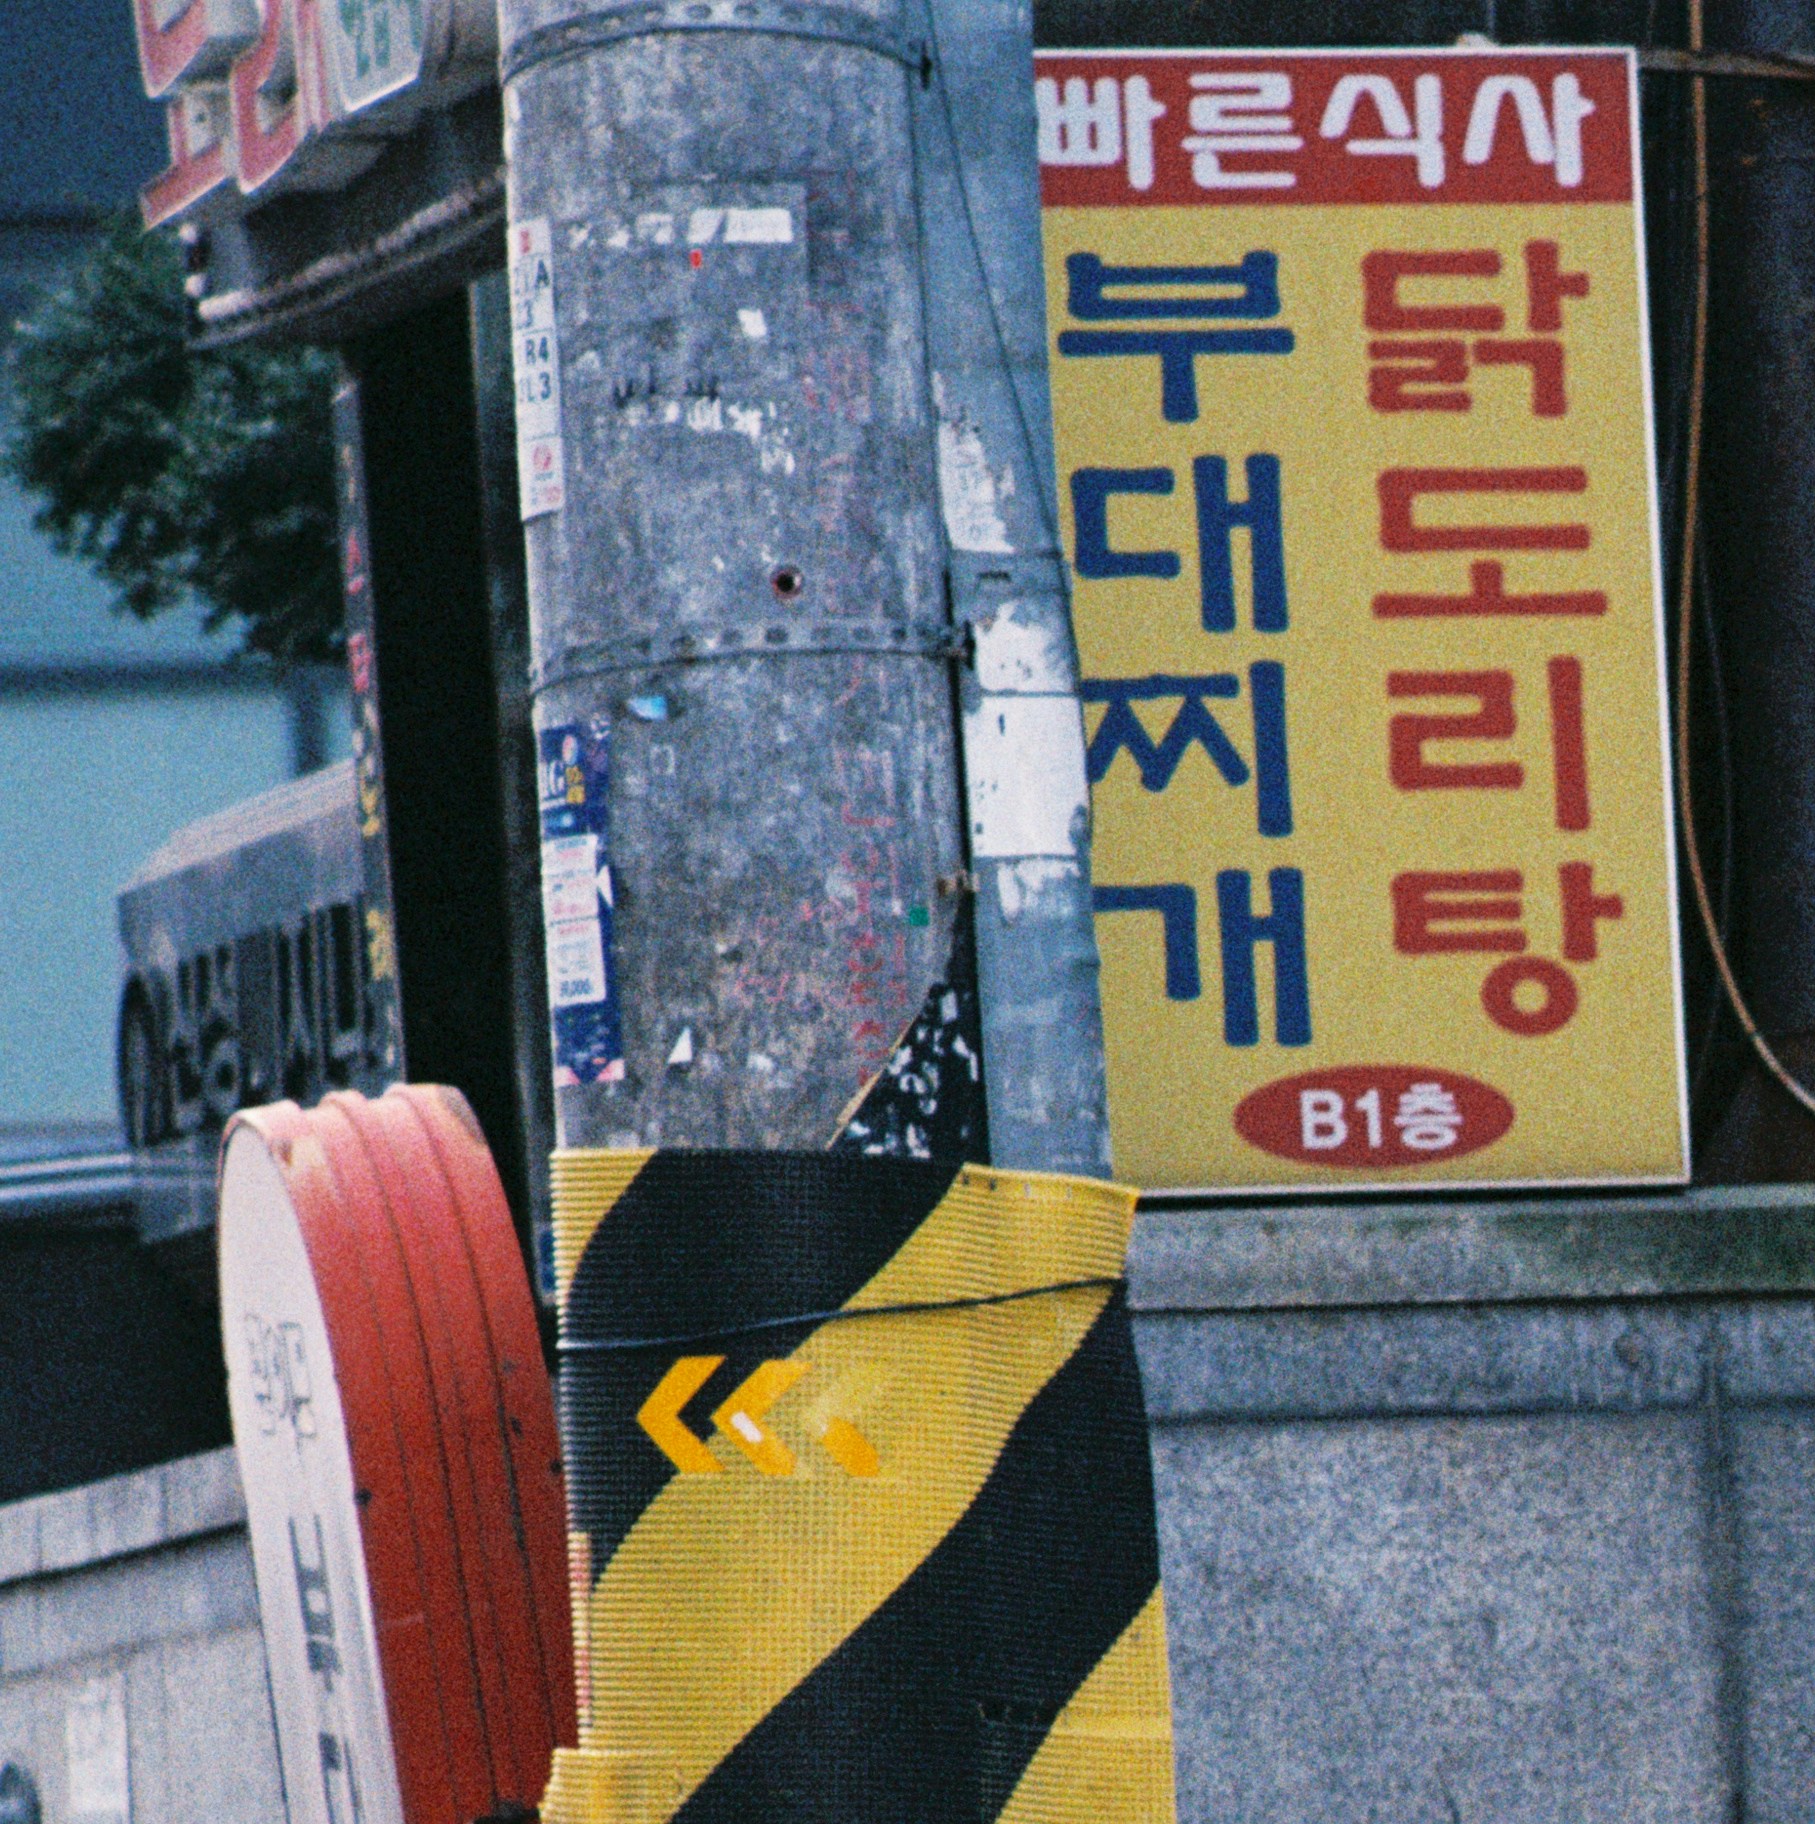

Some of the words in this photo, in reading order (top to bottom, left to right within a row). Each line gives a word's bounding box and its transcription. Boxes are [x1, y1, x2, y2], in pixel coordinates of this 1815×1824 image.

[1035, 70, 1595, 192] 빠른식사
[1057, 249, 1313, 1048] 부대찌개
[1361, 237, 1624, 1037] 닭도리탕
[1299, 1083, 1463, 1151] B1층
